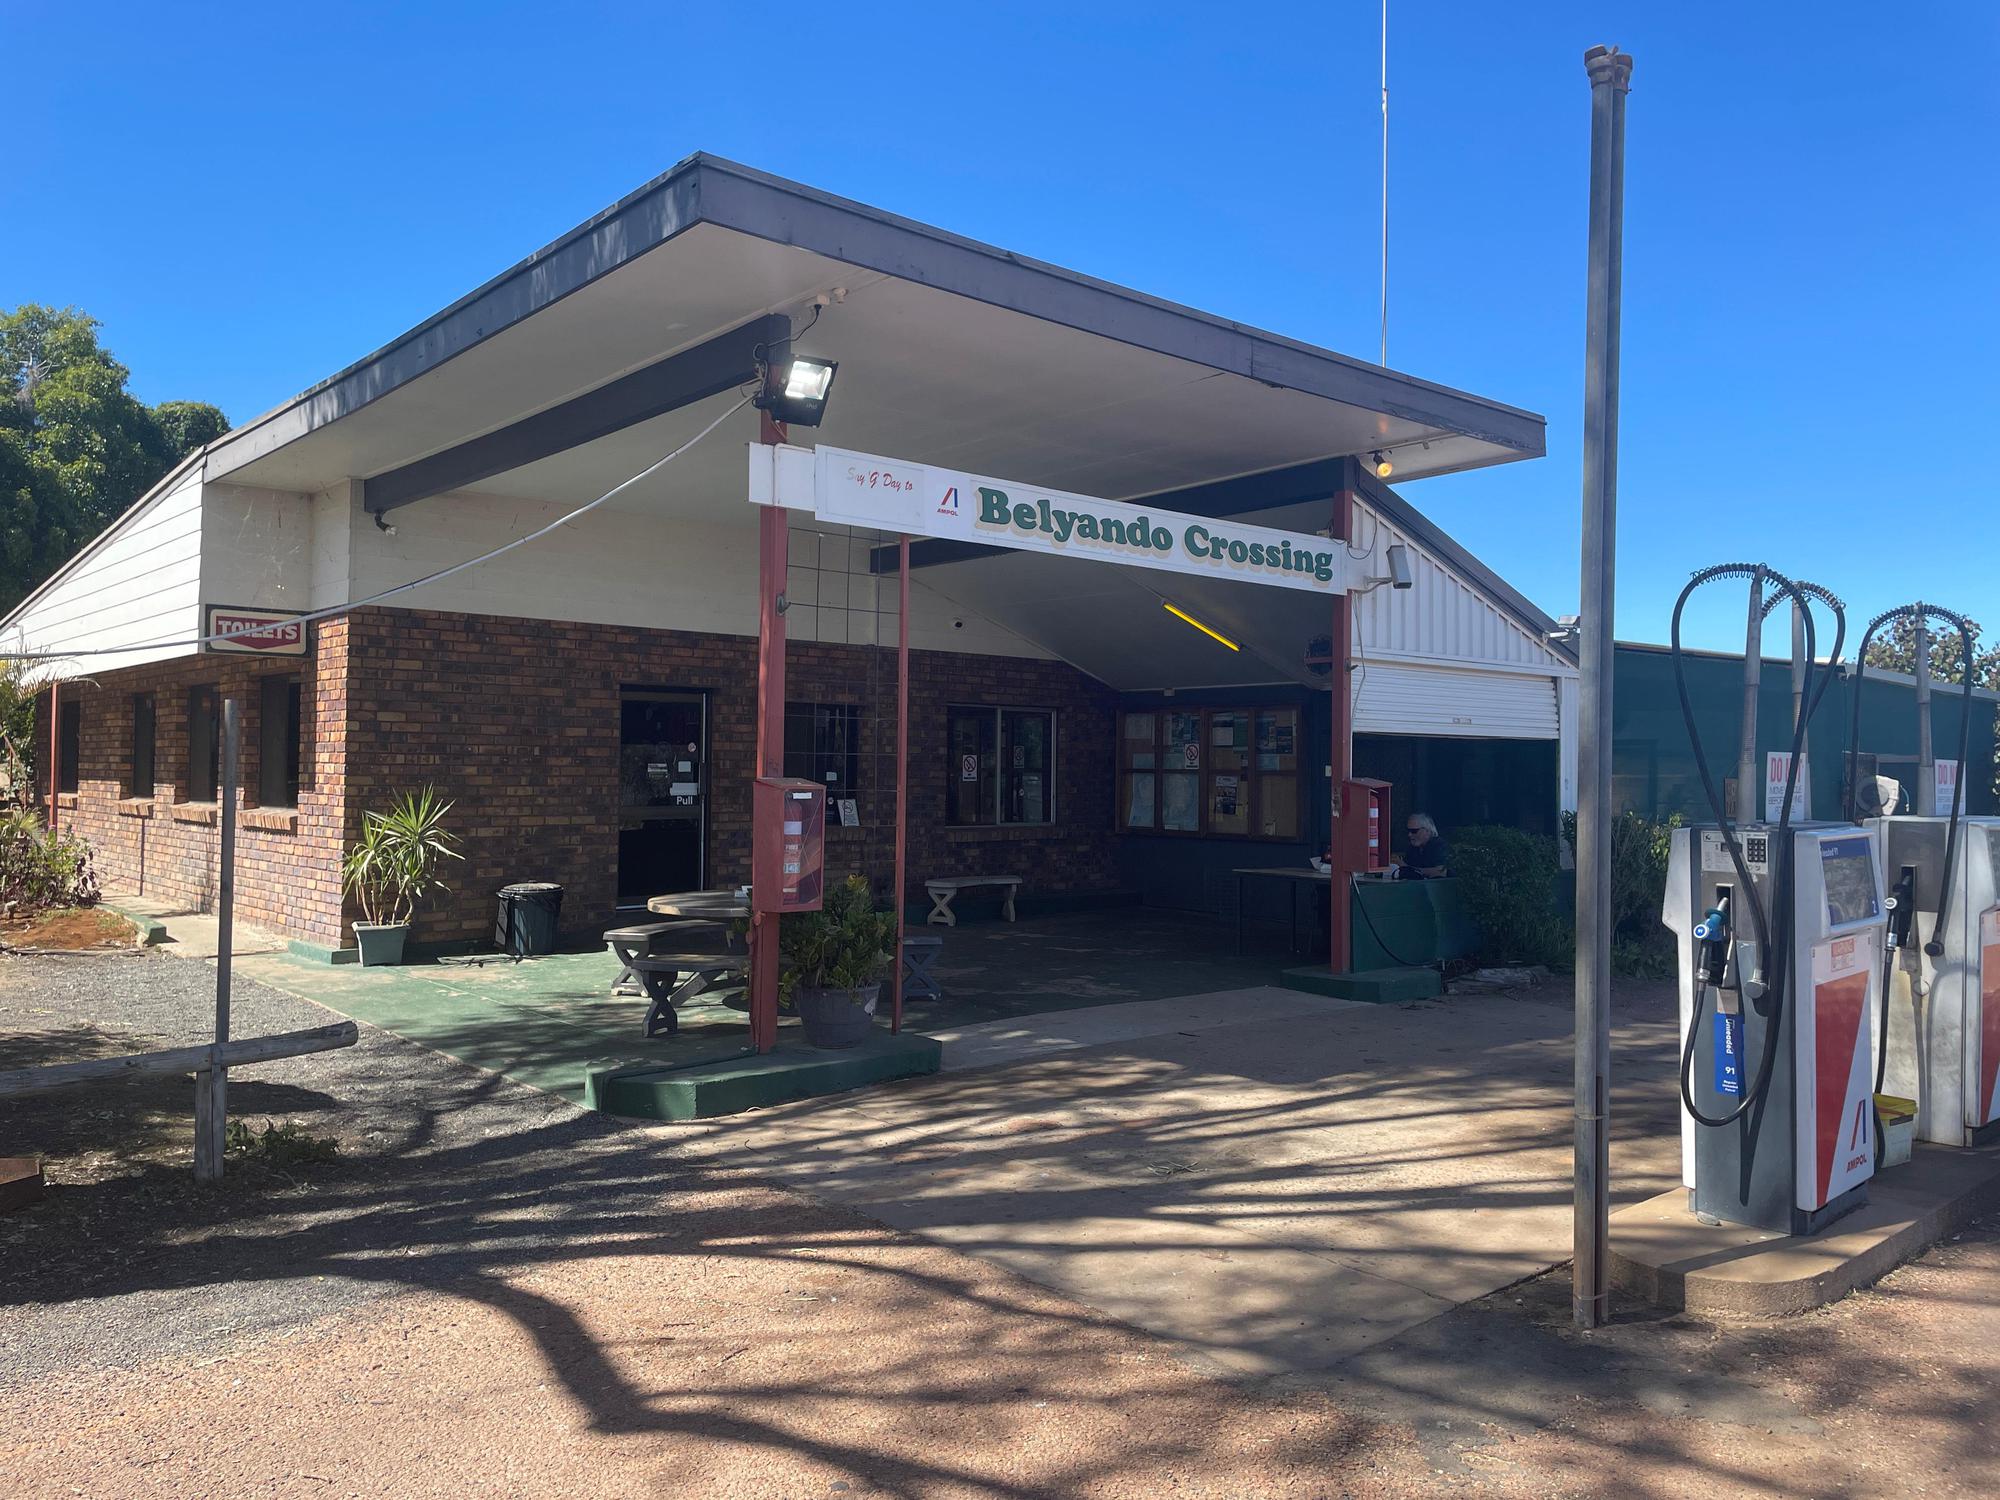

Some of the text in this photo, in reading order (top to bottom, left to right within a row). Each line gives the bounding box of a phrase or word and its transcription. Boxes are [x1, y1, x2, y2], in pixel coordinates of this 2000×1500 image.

[883, 473, 901, 492] Day
[905, 481, 913, 491] to
[937, 508, 959, 517] AMPOL
[976, 487, 1334, 583] Belyando Crossing
[218, 620, 298, 640] TOILETS
[1770, 757, 1782, 782] DO
[676, 796, 693, 805] Pull
[1725, 1019, 1733, 1054] Unleaded
[1725, 1066, 1735, 1075] 91
[1846, 1153, 1867, 1173] AMPOL
